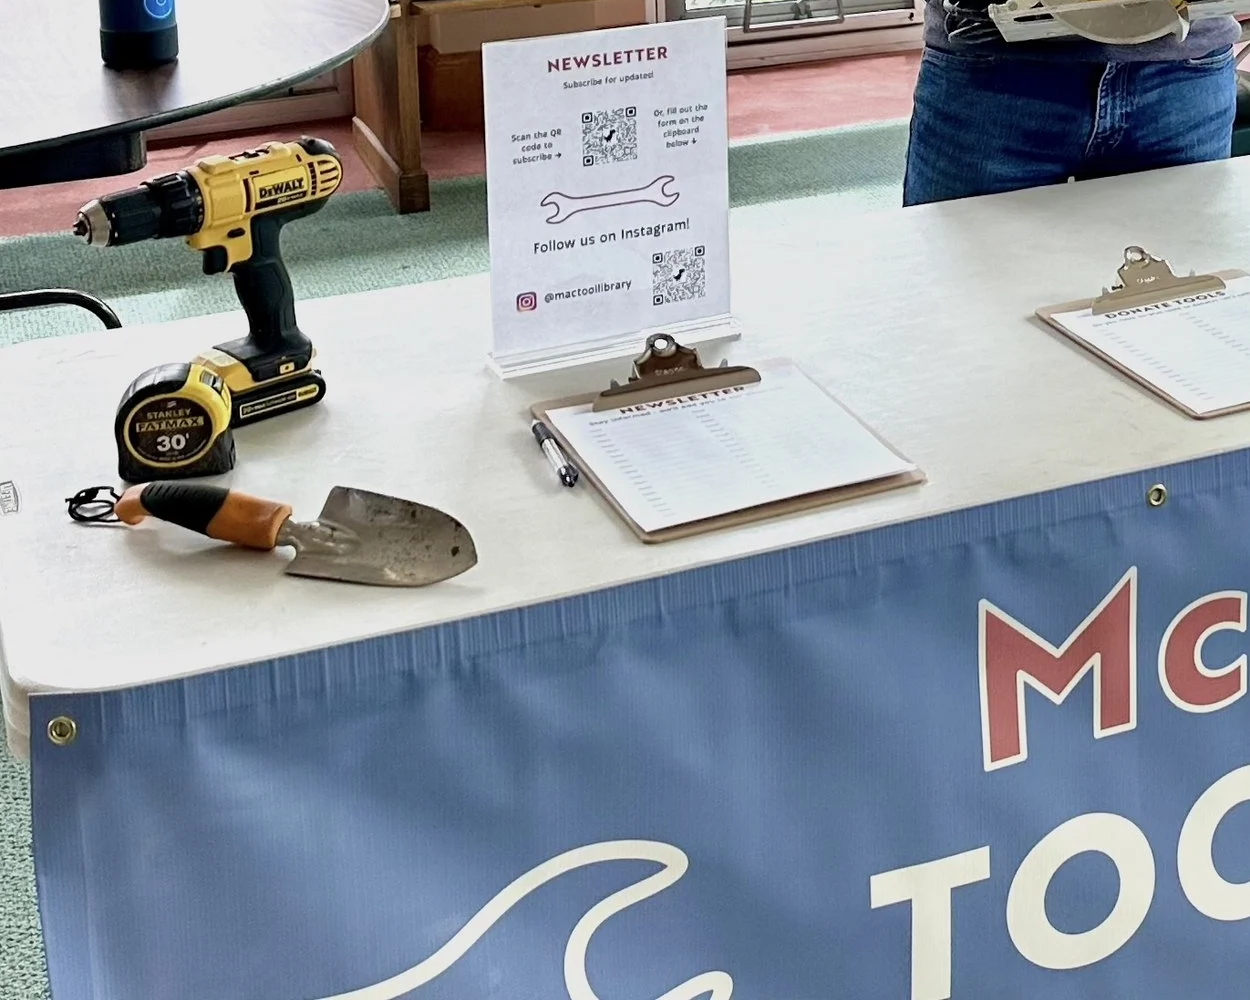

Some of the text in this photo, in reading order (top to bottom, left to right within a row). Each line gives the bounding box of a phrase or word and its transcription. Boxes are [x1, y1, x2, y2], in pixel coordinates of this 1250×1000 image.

[547, 46, 669, 73] NEWSLETTER
[563, 71, 654, 90] Subscribe for updates!
[666, 106, 678, 116] fill
[679, 105, 693, 114] out
[694, 103, 708, 112] the
[657, 114, 705, 129] form on the
[511, 128, 562, 143] Scan the QR
[663, 126, 700, 140] clipboard
[521, 141, 553, 152] code to
[666, 138, 689, 149] below
[512, 152, 553, 165] subscribe
[533, 217, 690, 255] Follow us on Instagram!
[544, 279, 632, 304] @mactoollibrary
[1104, 302, 1169, 319] DONATE
[1173, 291, 1226, 306] TOOLS
[620, 386, 745, 414] NEWSLETTER
[146, 408, 192, 420] STANLEY
[139, 416, 202, 432] FATMAX
[156, 432, 190, 452] 30'
